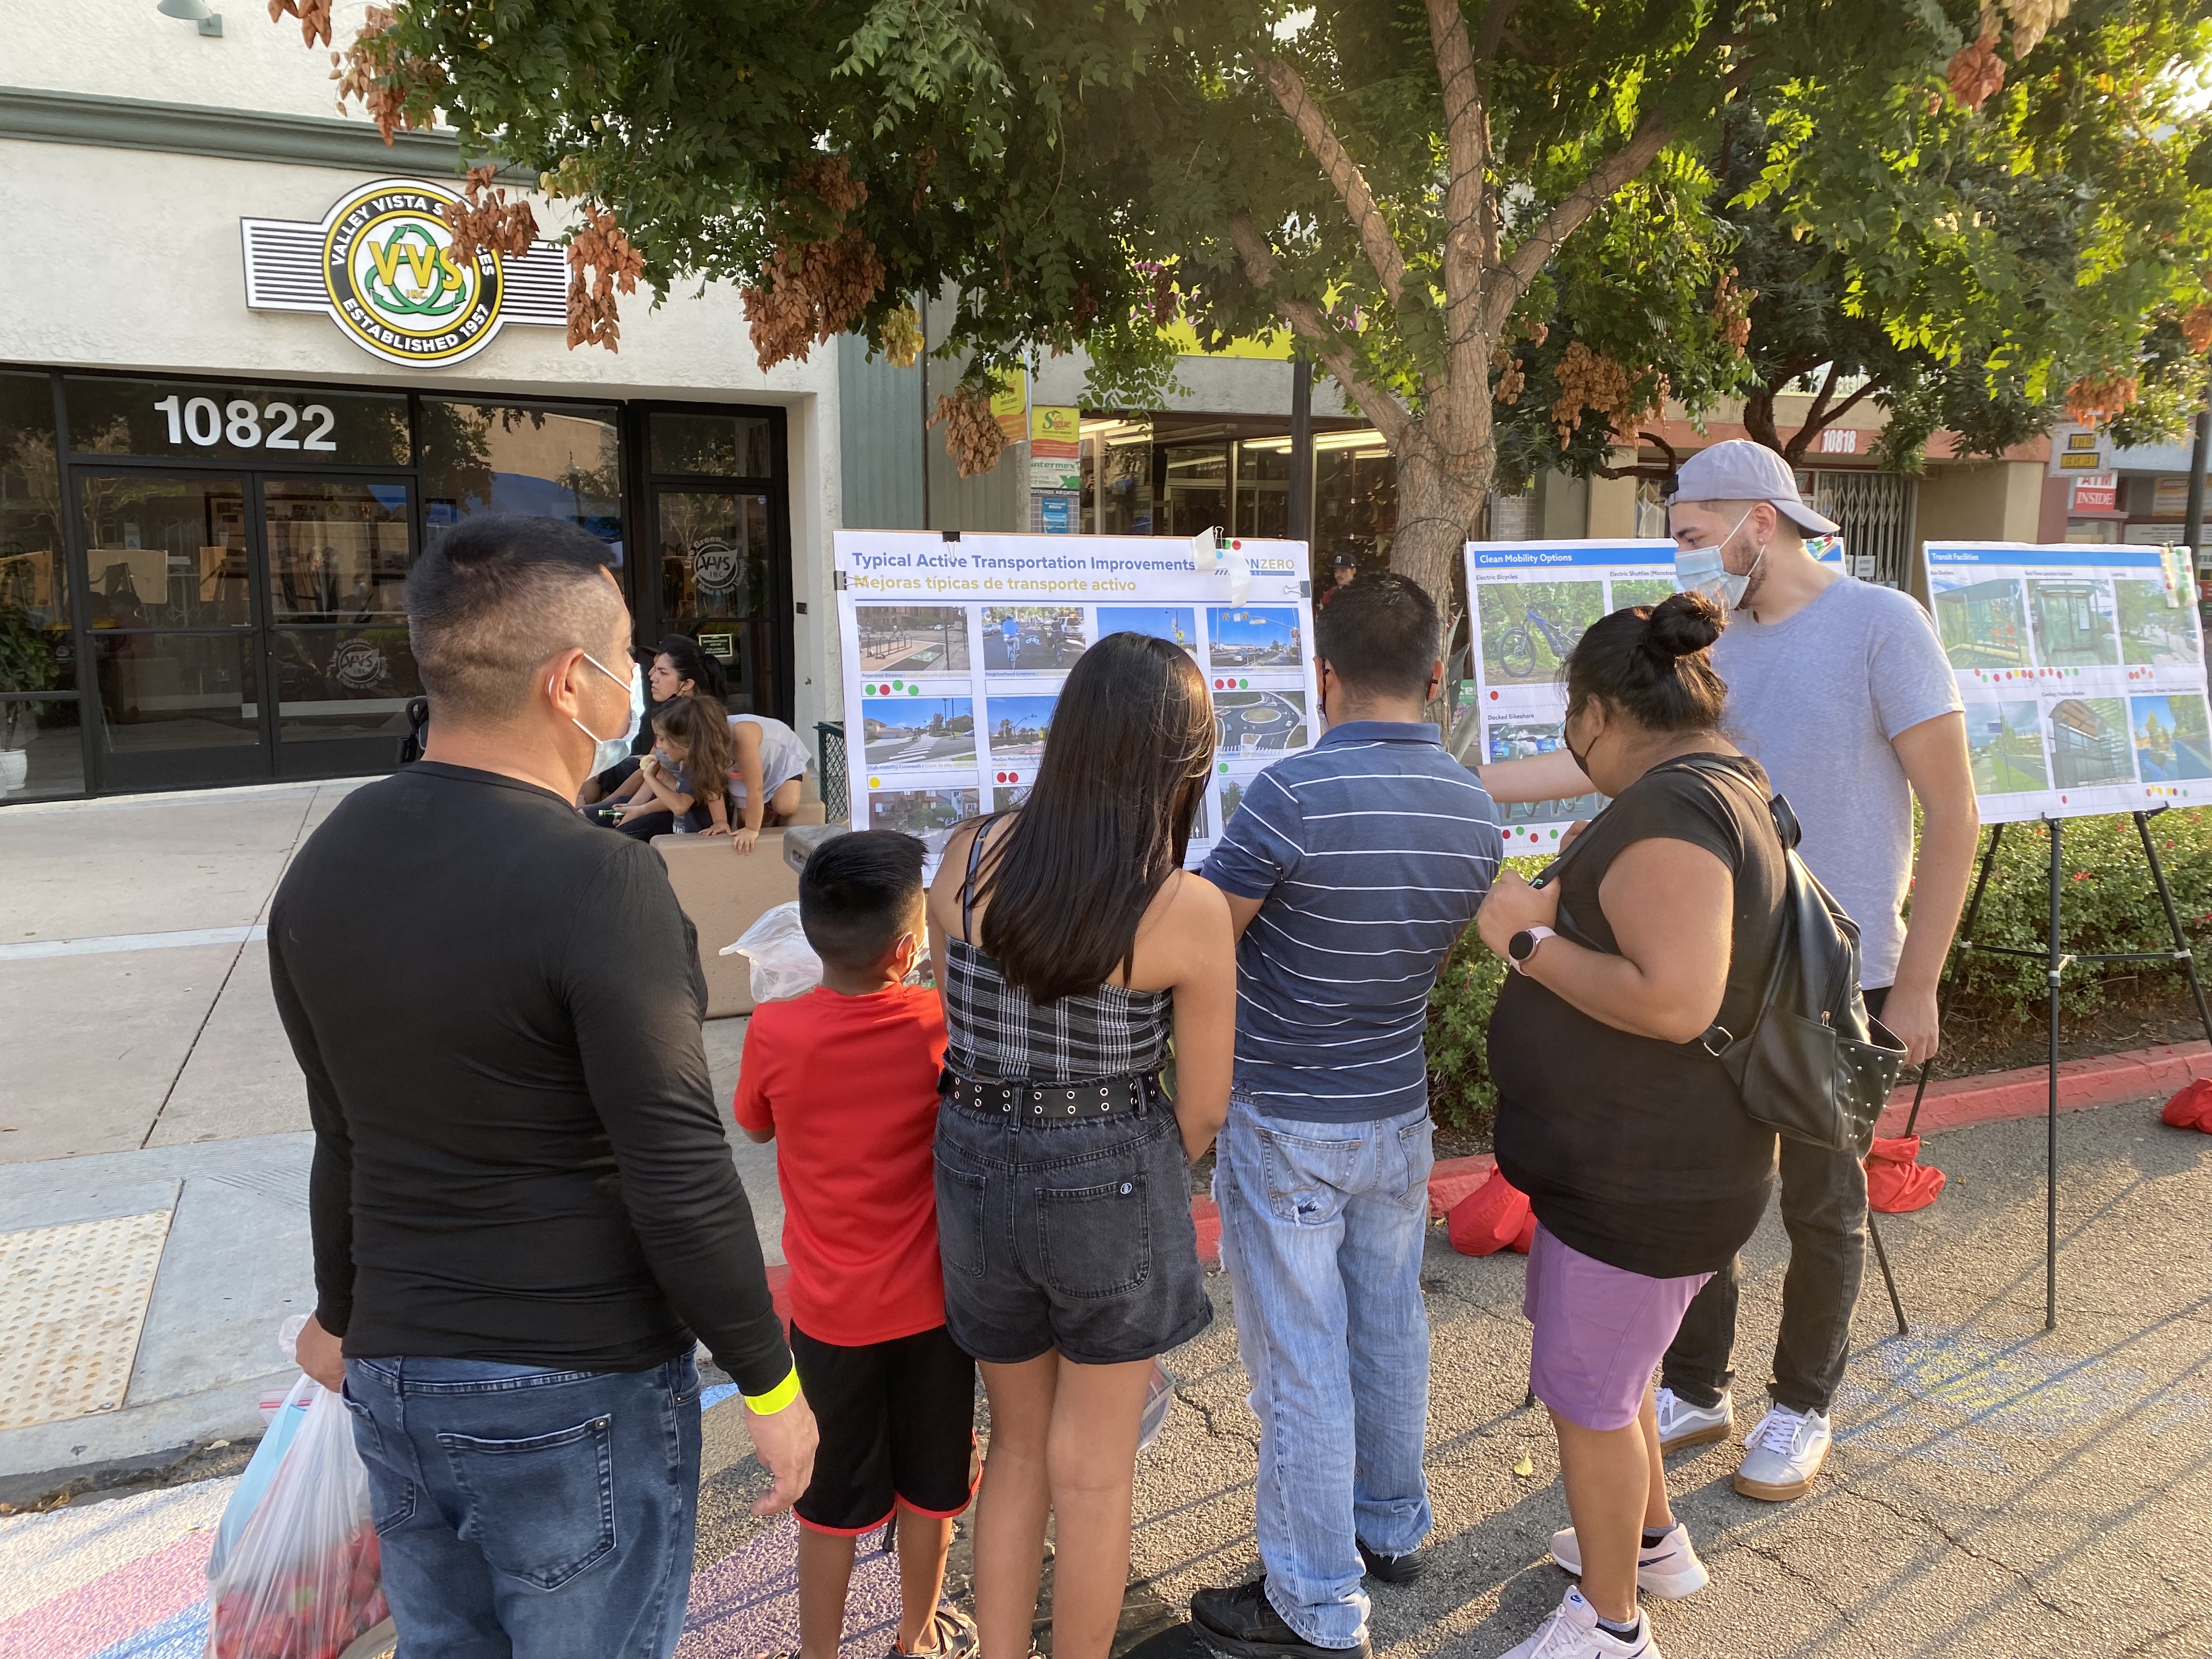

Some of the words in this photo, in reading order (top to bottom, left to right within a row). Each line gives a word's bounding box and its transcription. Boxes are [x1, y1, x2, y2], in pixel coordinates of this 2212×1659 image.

[331, 207, 372, 266] VALLEY
[371, 195, 429, 212] VISTA
[367, 241, 463, 290] VVS
[405, 289, 428, 300] INC.
[342, 297, 459, 352] ESTABLISHED
[459, 303, 489, 338] 1957
[154, 394, 337, 452] 10822
[1042, 411, 1071, 430] Sigue
[1823, 428, 1857, 453] 10818
[1031, 460, 1075, 470] intermex
[2081, 472, 2112, 486] ATM
[2077, 492, 2113, 505] INSIDE
[852, 552, 910, 570] Typical
[916, 553, 967, 568] Active
[972, 555, 1086, 572] Transportation
[1091, 556, 1195, 573] Improvements
[1480, 555, 1503, 564] Clean
[1505, 554, 1538, 565] Mobility
[1540, 553, 1572, 563] Options
[1953, 552, 1979, 561] Facilities
[854, 574, 921, 592] Mejoras
[926, 575, 979, 592] típicas
[984, 577, 1003, 590] de
[1007, 577, 1087, 593] transporte
[1092, 578, 1136, 591] activo
